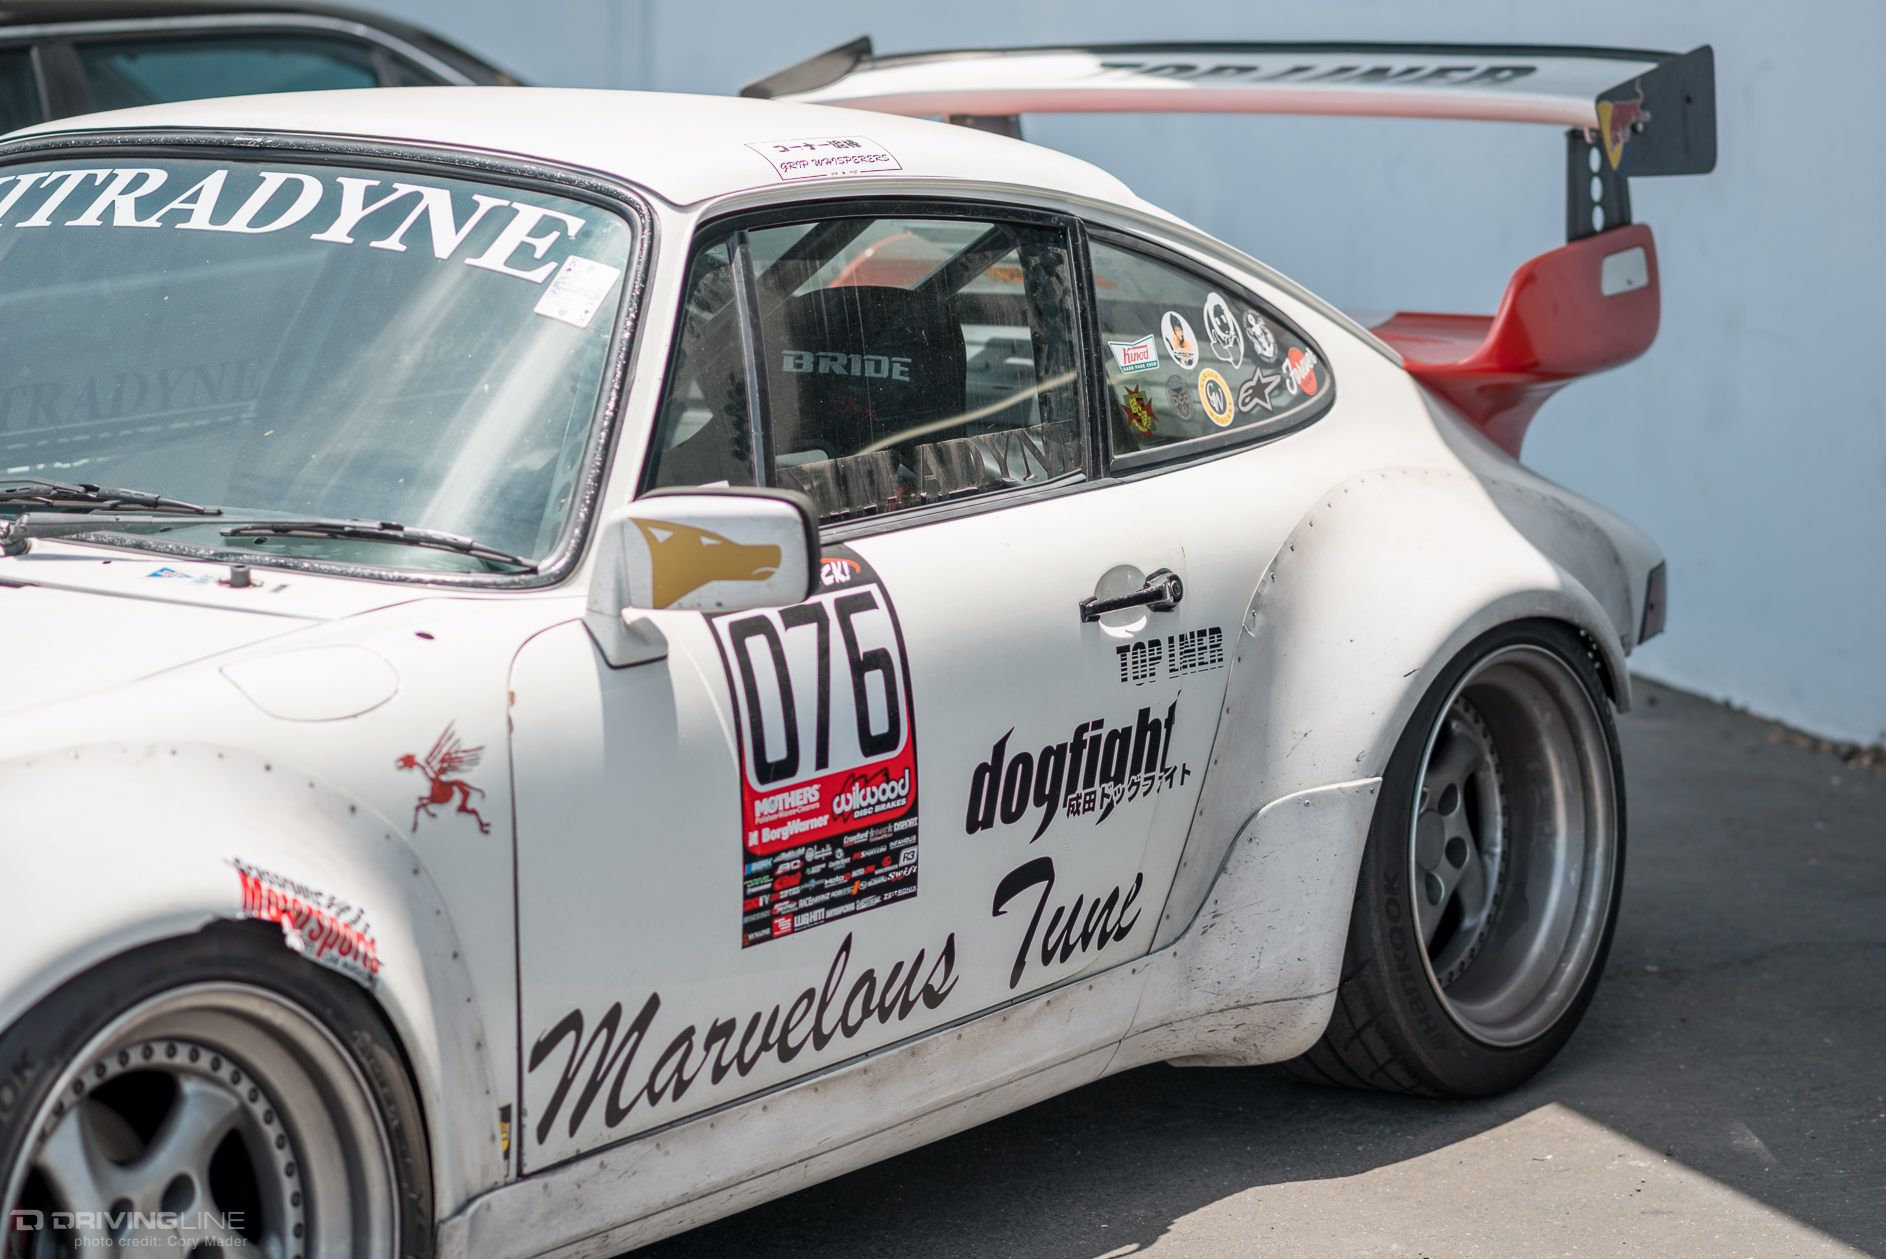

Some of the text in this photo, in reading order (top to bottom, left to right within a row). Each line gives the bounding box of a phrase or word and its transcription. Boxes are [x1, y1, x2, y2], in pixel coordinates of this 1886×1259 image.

[780, 154, 889, 173] GRIP WHISPERERS
[0, 168, 586, 283] ITRADYNE
[781, 350, 912, 383] BRIDE
[1116, 638, 1162, 686] TOP
[728, 590, 900, 786] 076
[965, 689, 1182, 844] dogfight
[754, 784, 820, 817] MOTHERS
[854, 798, 907, 818] DISC BRAKES
[762, 814, 829, 843] BorgWarner
[888, 865, 917, 880] Swift
[528, 931, 960, 1146] Marvelous
[991, 856, 1143, 990] Tune
